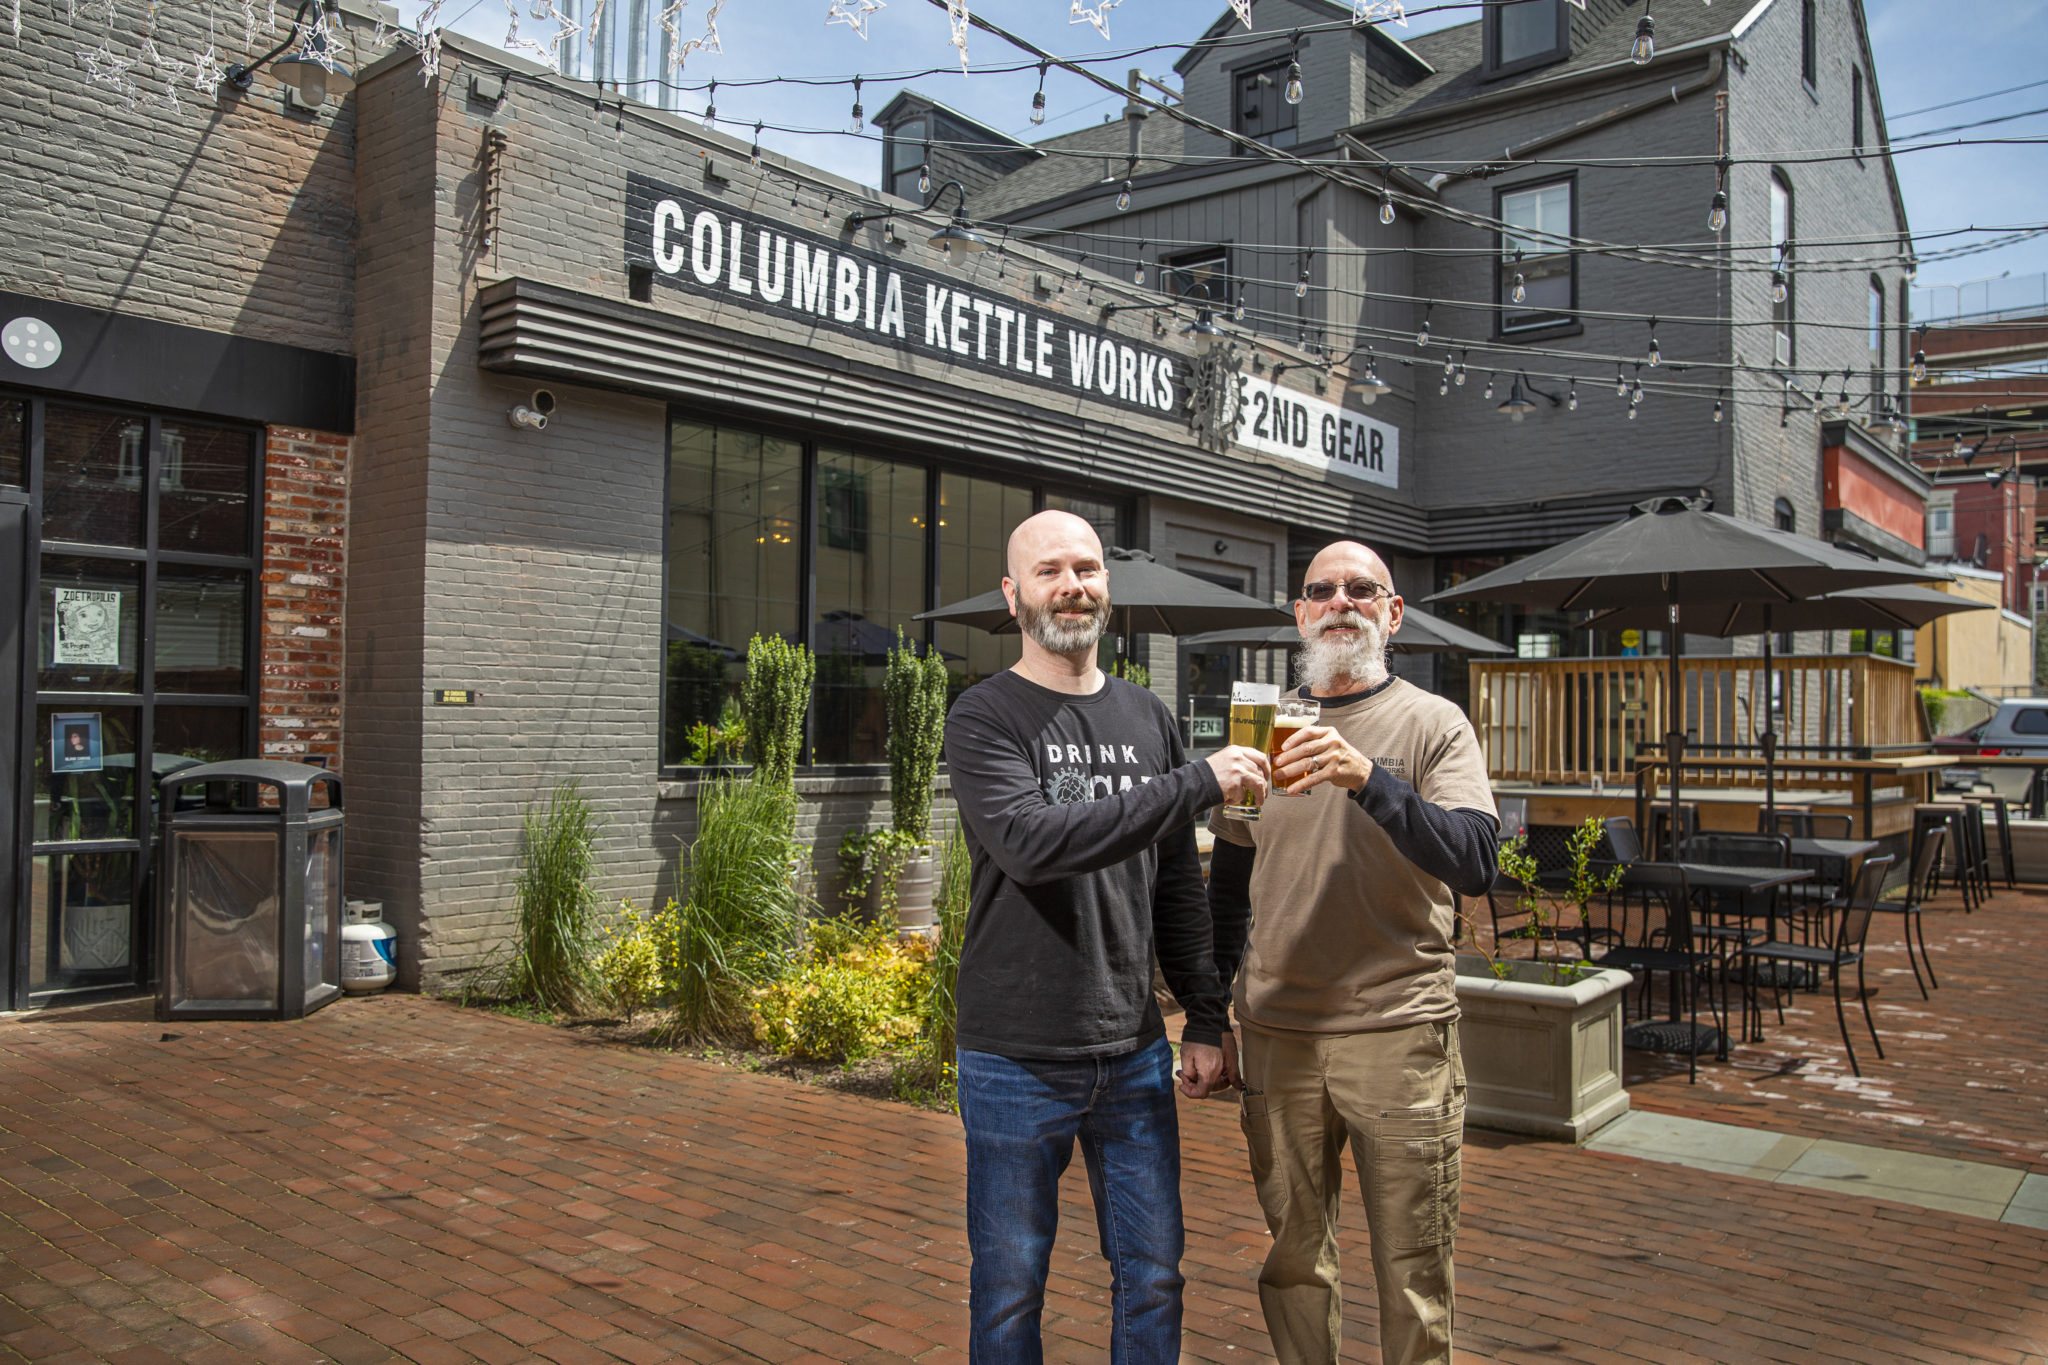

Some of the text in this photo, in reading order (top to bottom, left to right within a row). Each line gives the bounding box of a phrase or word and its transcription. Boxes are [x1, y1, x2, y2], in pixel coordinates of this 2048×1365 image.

[653, 200, 1174, 411] COLUMBIA KETTLE WORKS
[1253, 391, 1384, 472] 2ND GEAR
[1046, 744, 1139, 764] DRINK
[1372, 757, 1405, 767] UMBIA
